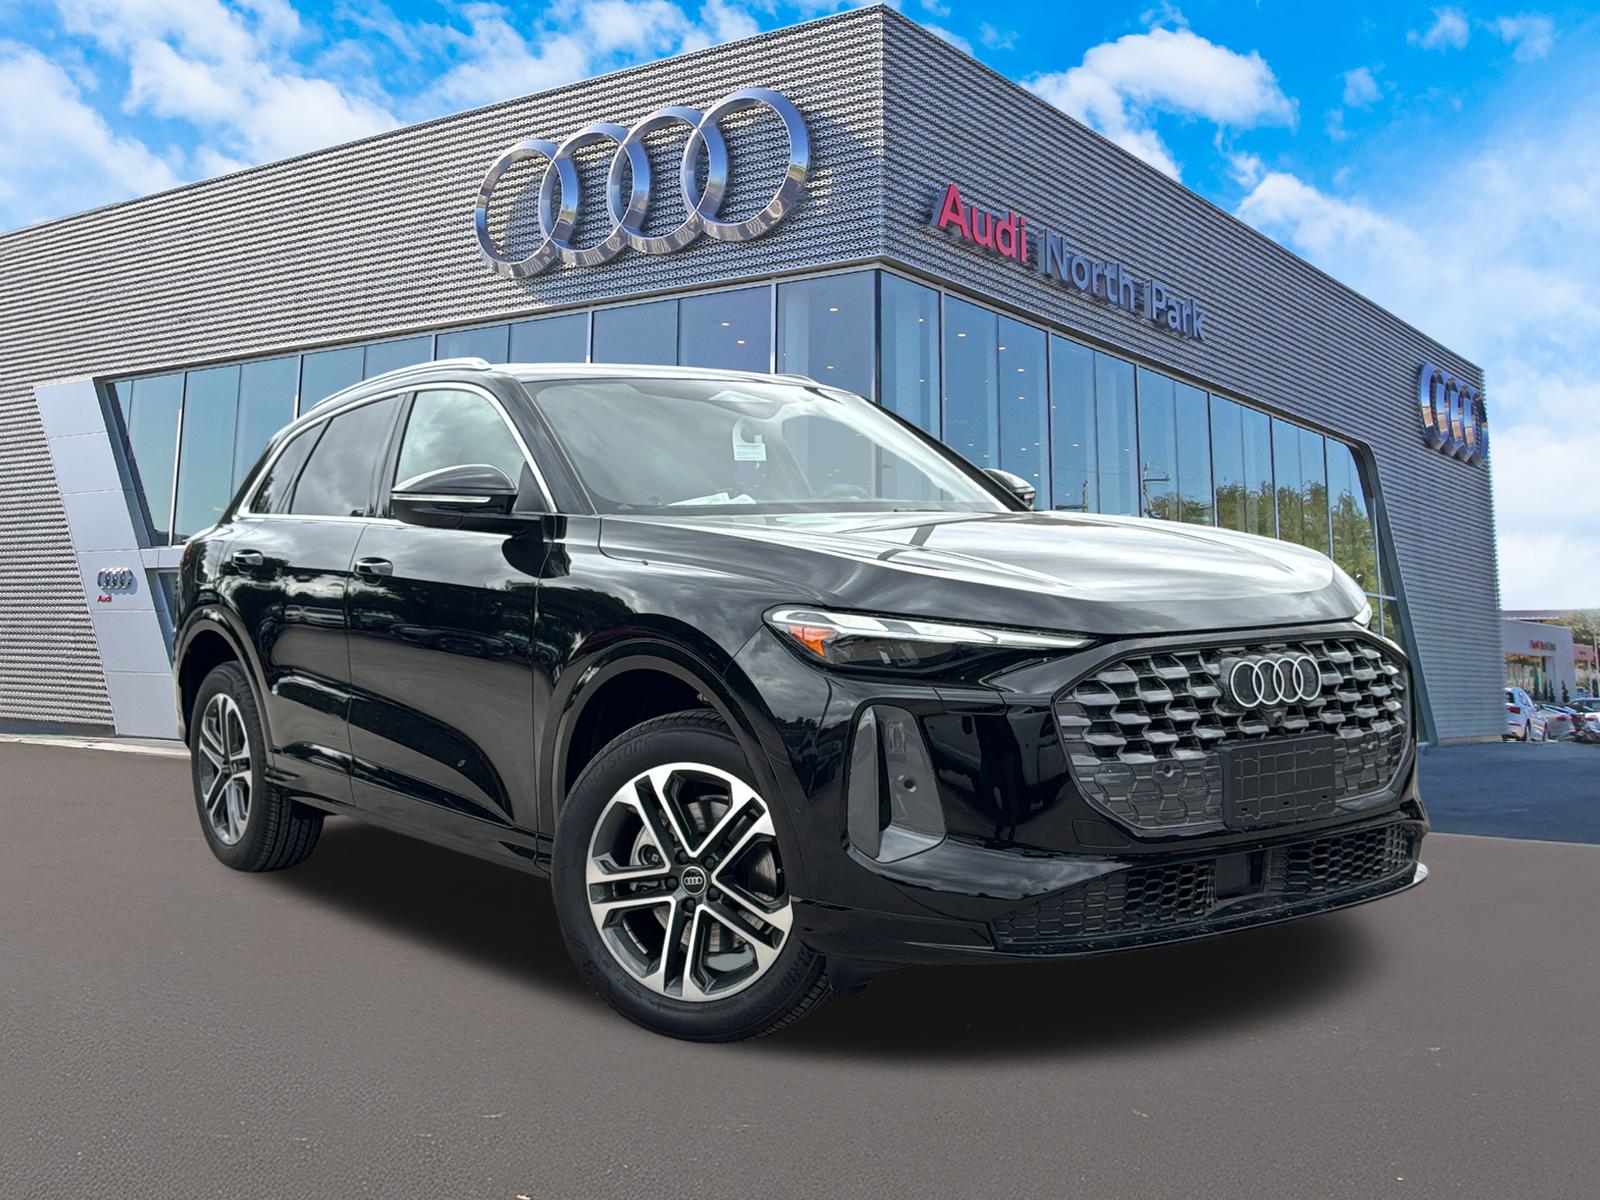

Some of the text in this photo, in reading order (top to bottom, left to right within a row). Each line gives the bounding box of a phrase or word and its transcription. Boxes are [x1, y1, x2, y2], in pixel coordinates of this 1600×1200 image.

[937, 183, 1206, 342] Audi North Park
